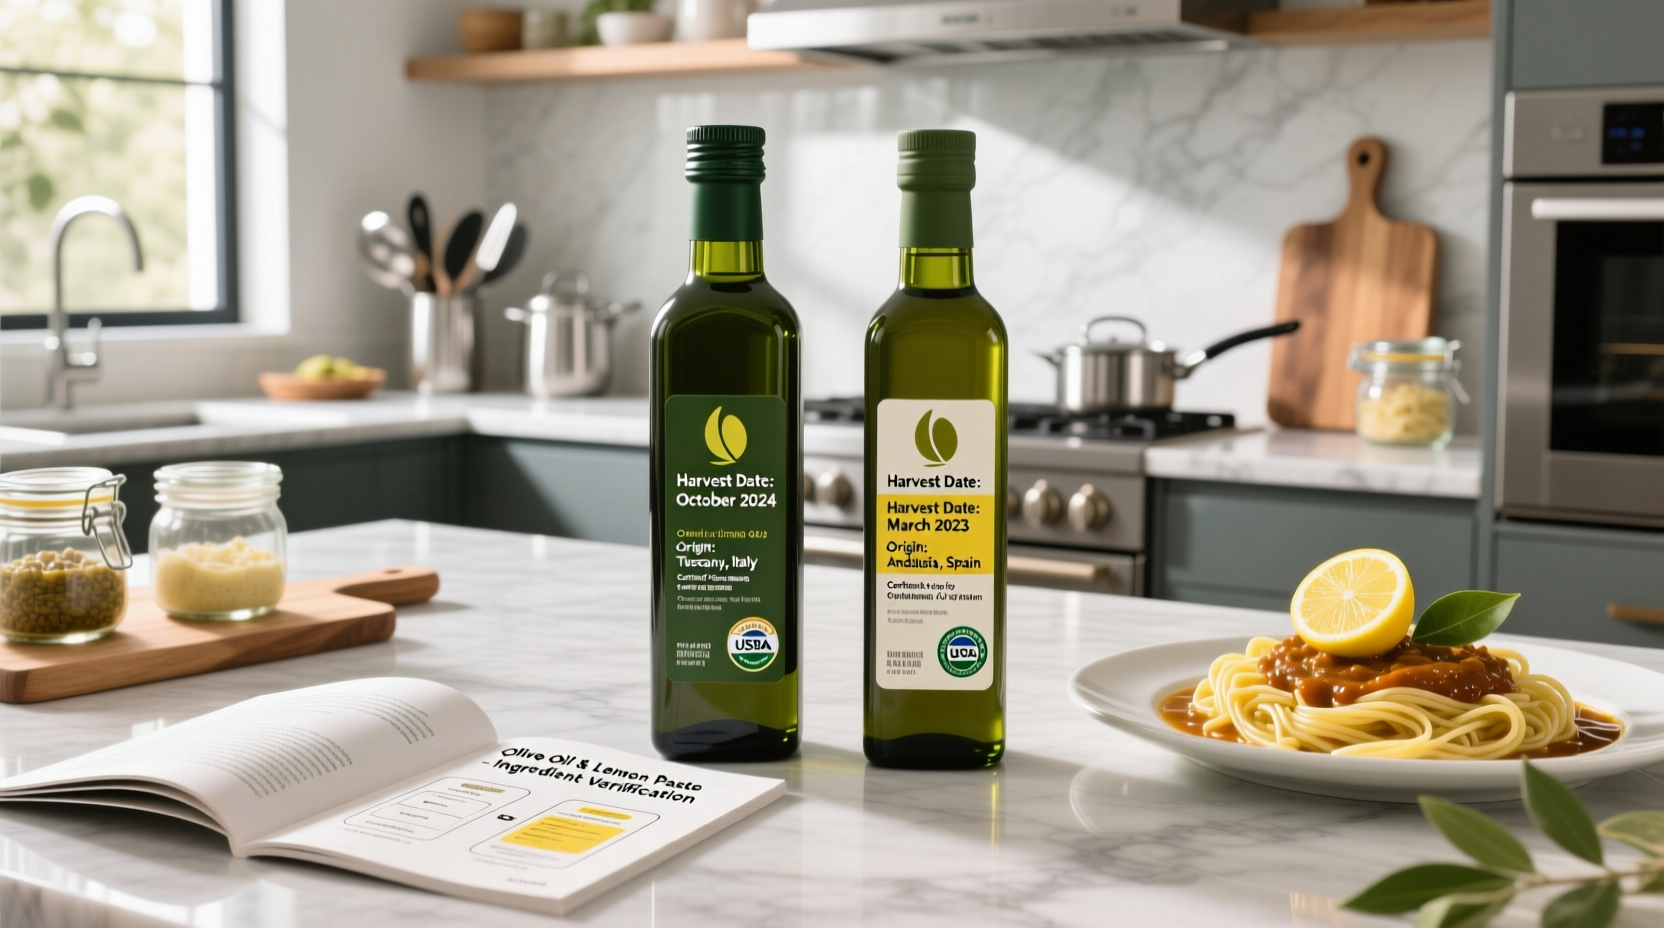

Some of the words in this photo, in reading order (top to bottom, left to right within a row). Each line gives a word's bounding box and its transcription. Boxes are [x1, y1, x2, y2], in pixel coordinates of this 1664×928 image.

[677, 472, 732, 488] Harvest
[736, 473, 775, 488] Date:
[887, 474, 941, 488] Harvest
[944, 475, 981, 488] Date:
[676, 491, 736, 507] October
[740, 493, 777, 508] 2024
[887, 501, 939, 514] Harvest
[943, 501, 980, 514] Date:
[887, 518, 931, 532] March
[935, 519, 970, 532] 2023
[732, 555, 758, 571] Italy
[946, 556, 981, 571] Spain
